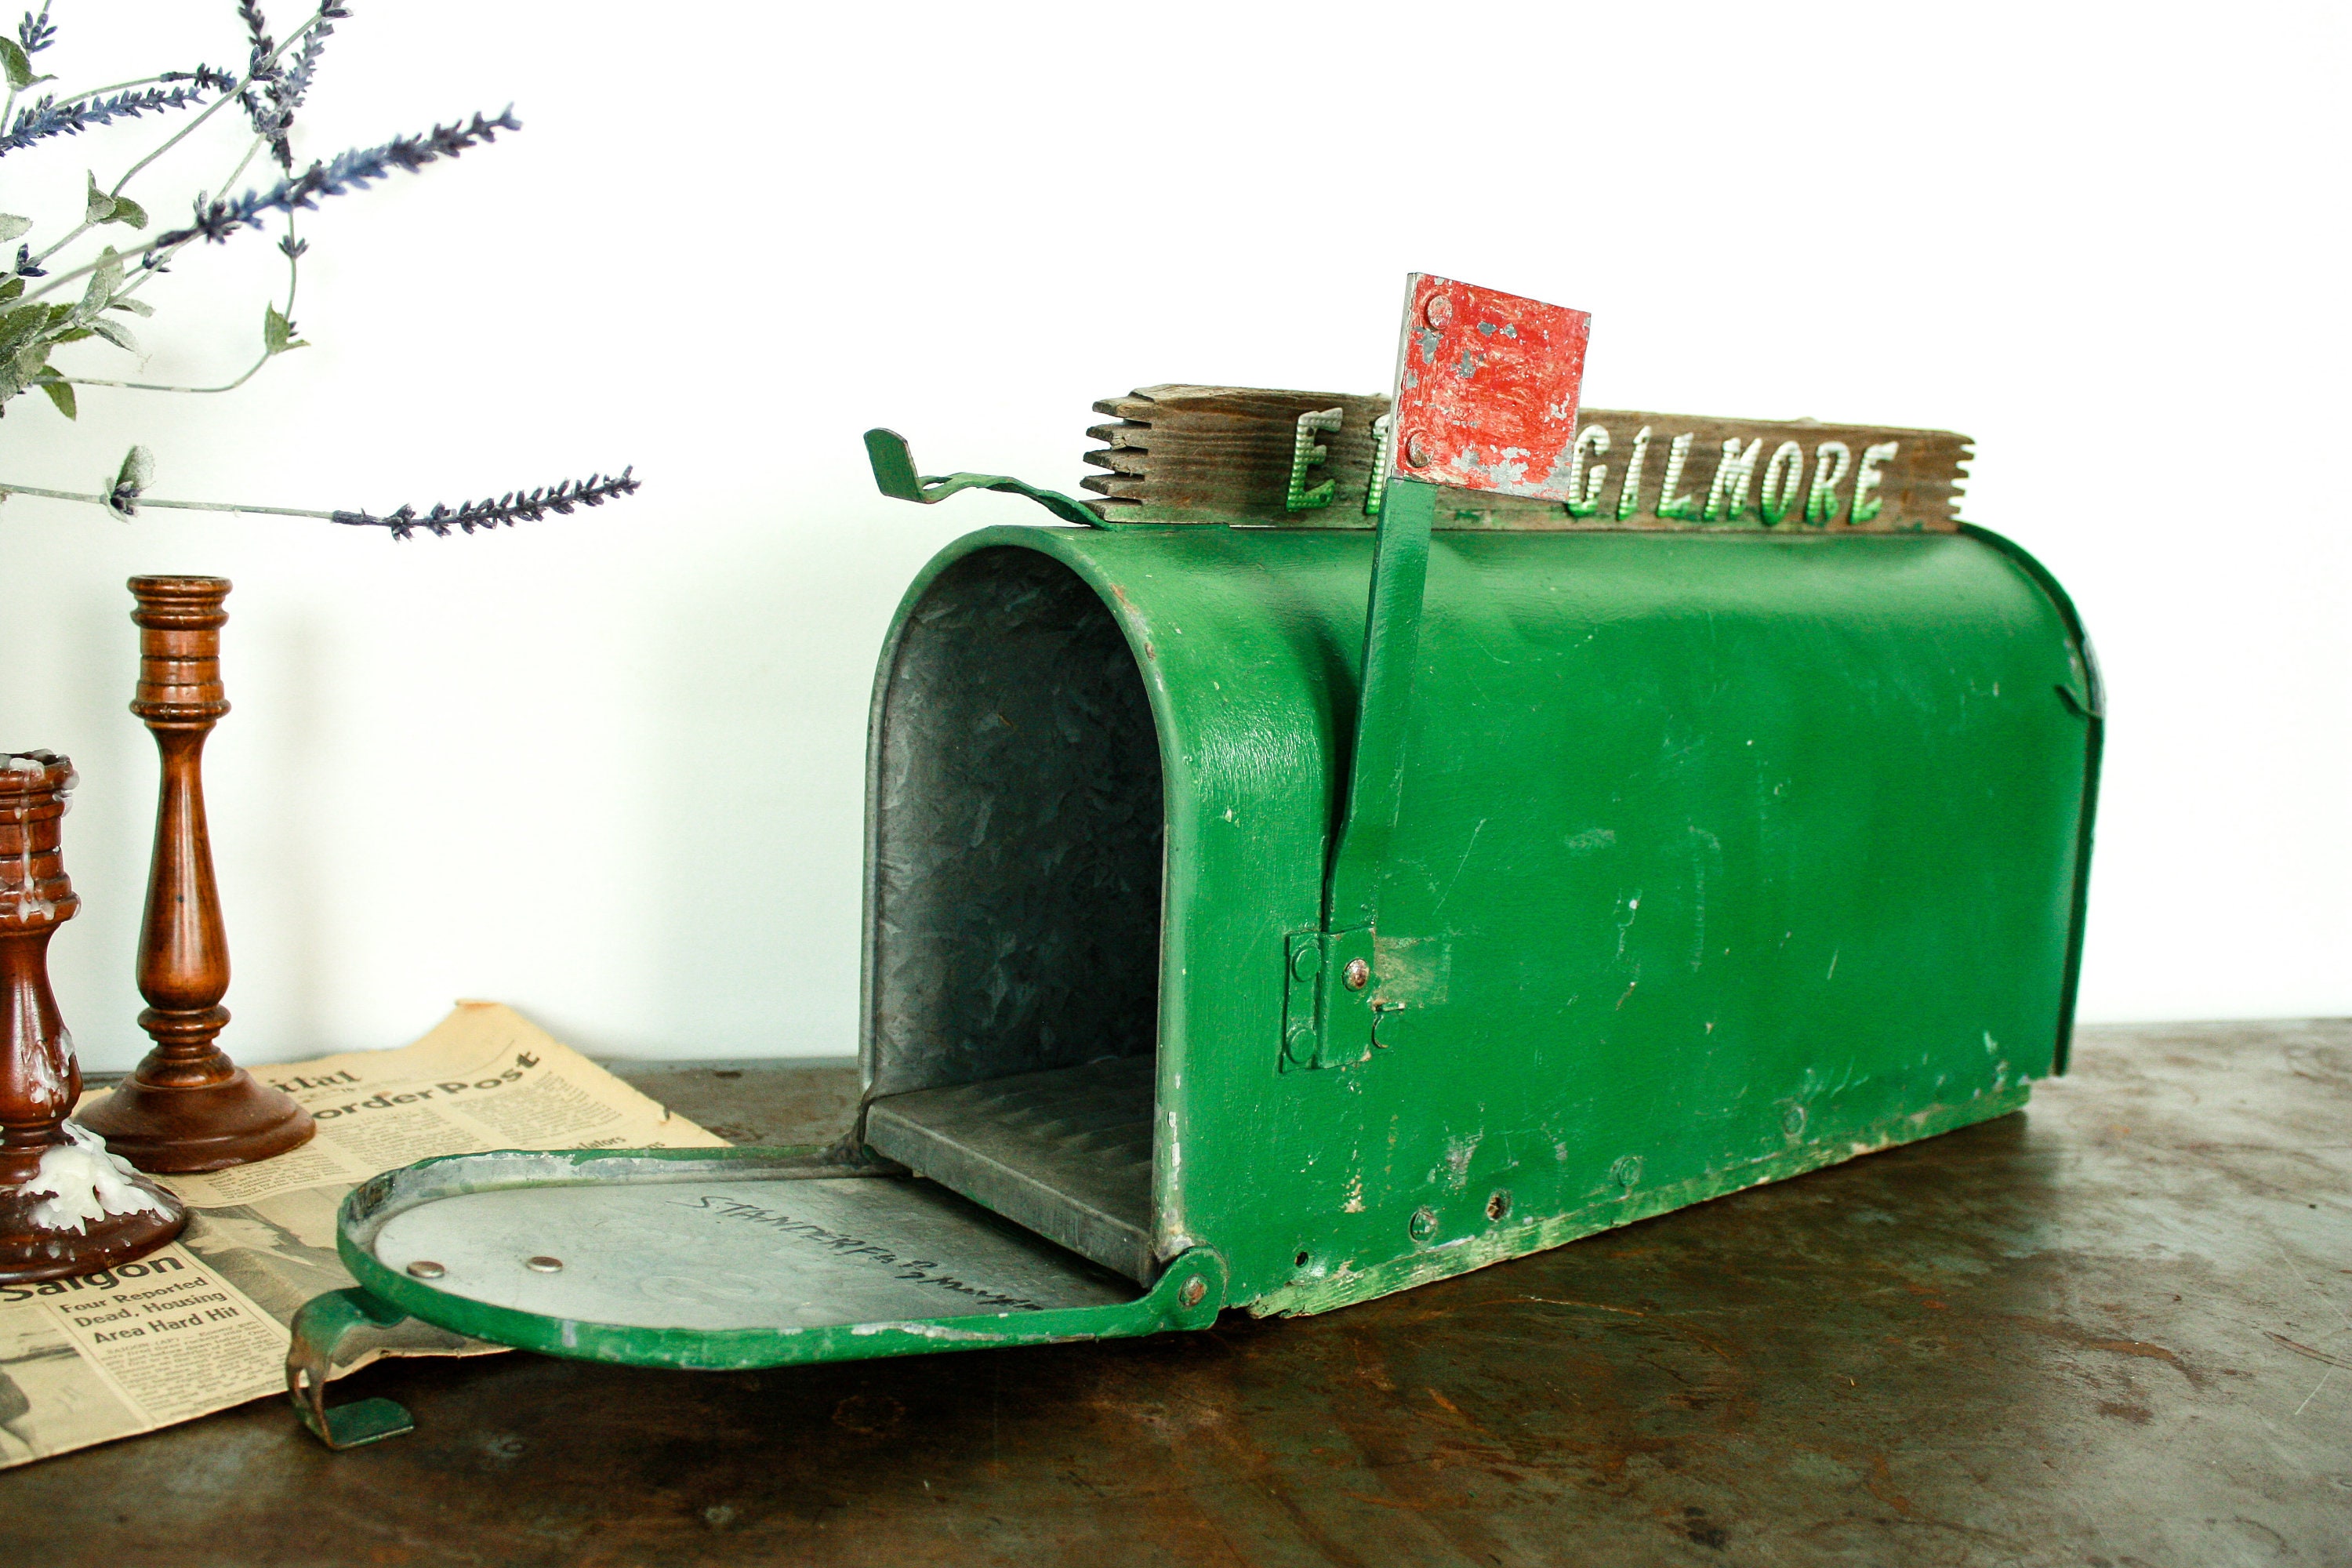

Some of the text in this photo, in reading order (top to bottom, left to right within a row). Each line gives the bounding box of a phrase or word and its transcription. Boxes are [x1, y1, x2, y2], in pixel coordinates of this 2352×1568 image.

[1286, 407, 1343, 513] E
[1566, 423, 1899, 526] GILMORE
[435, 1051, 541, 1095] Post
[60, 1276, 209, 1313] Four Reported
[142, 1292, 228, 1314] Housing
[95, 1305, 240, 1344] Area Hard Hit
